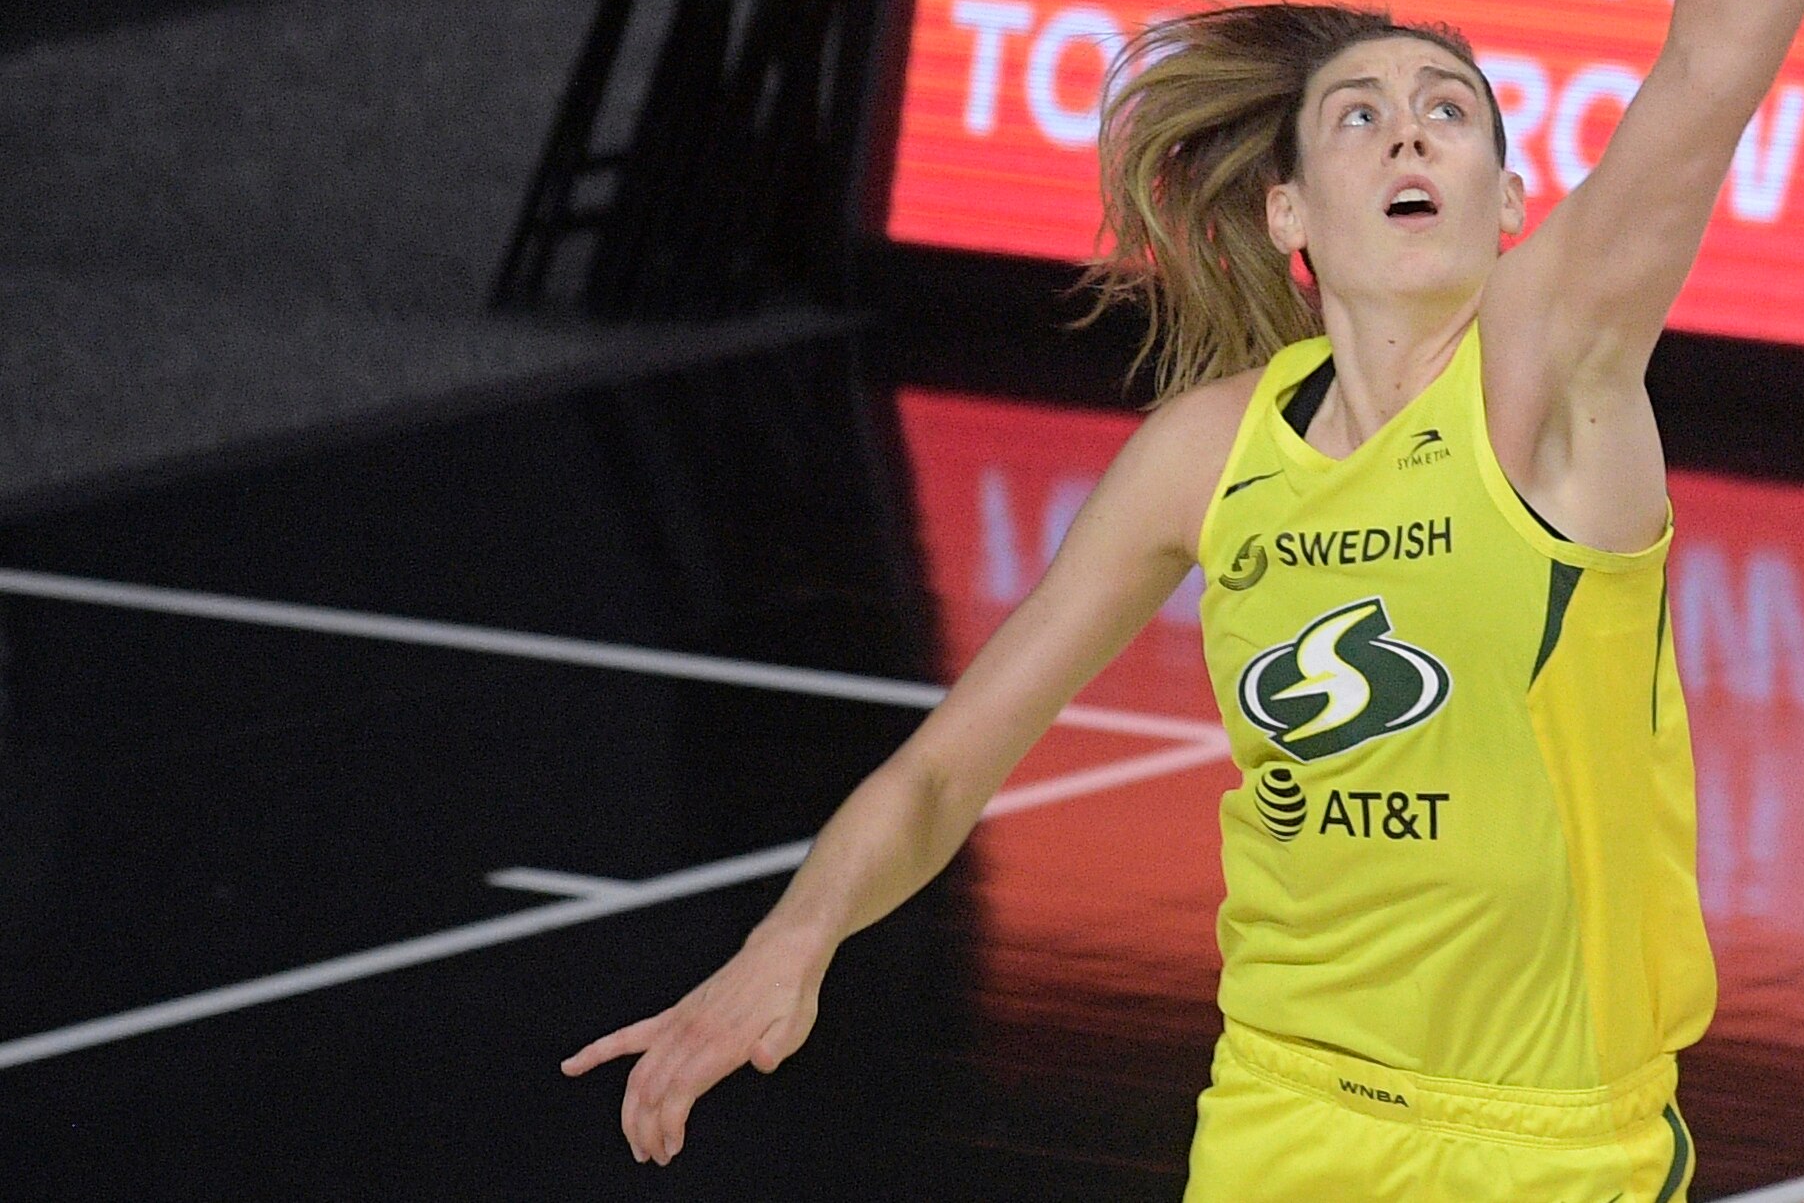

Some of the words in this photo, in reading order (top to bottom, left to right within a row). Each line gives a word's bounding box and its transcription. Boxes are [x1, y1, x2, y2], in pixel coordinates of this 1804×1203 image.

[1275, 517, 1452, 567] SWEDISH
[1318, 789, 1450, 840] AT&T
[1338, 1077, 1409, 1109] WNBA
